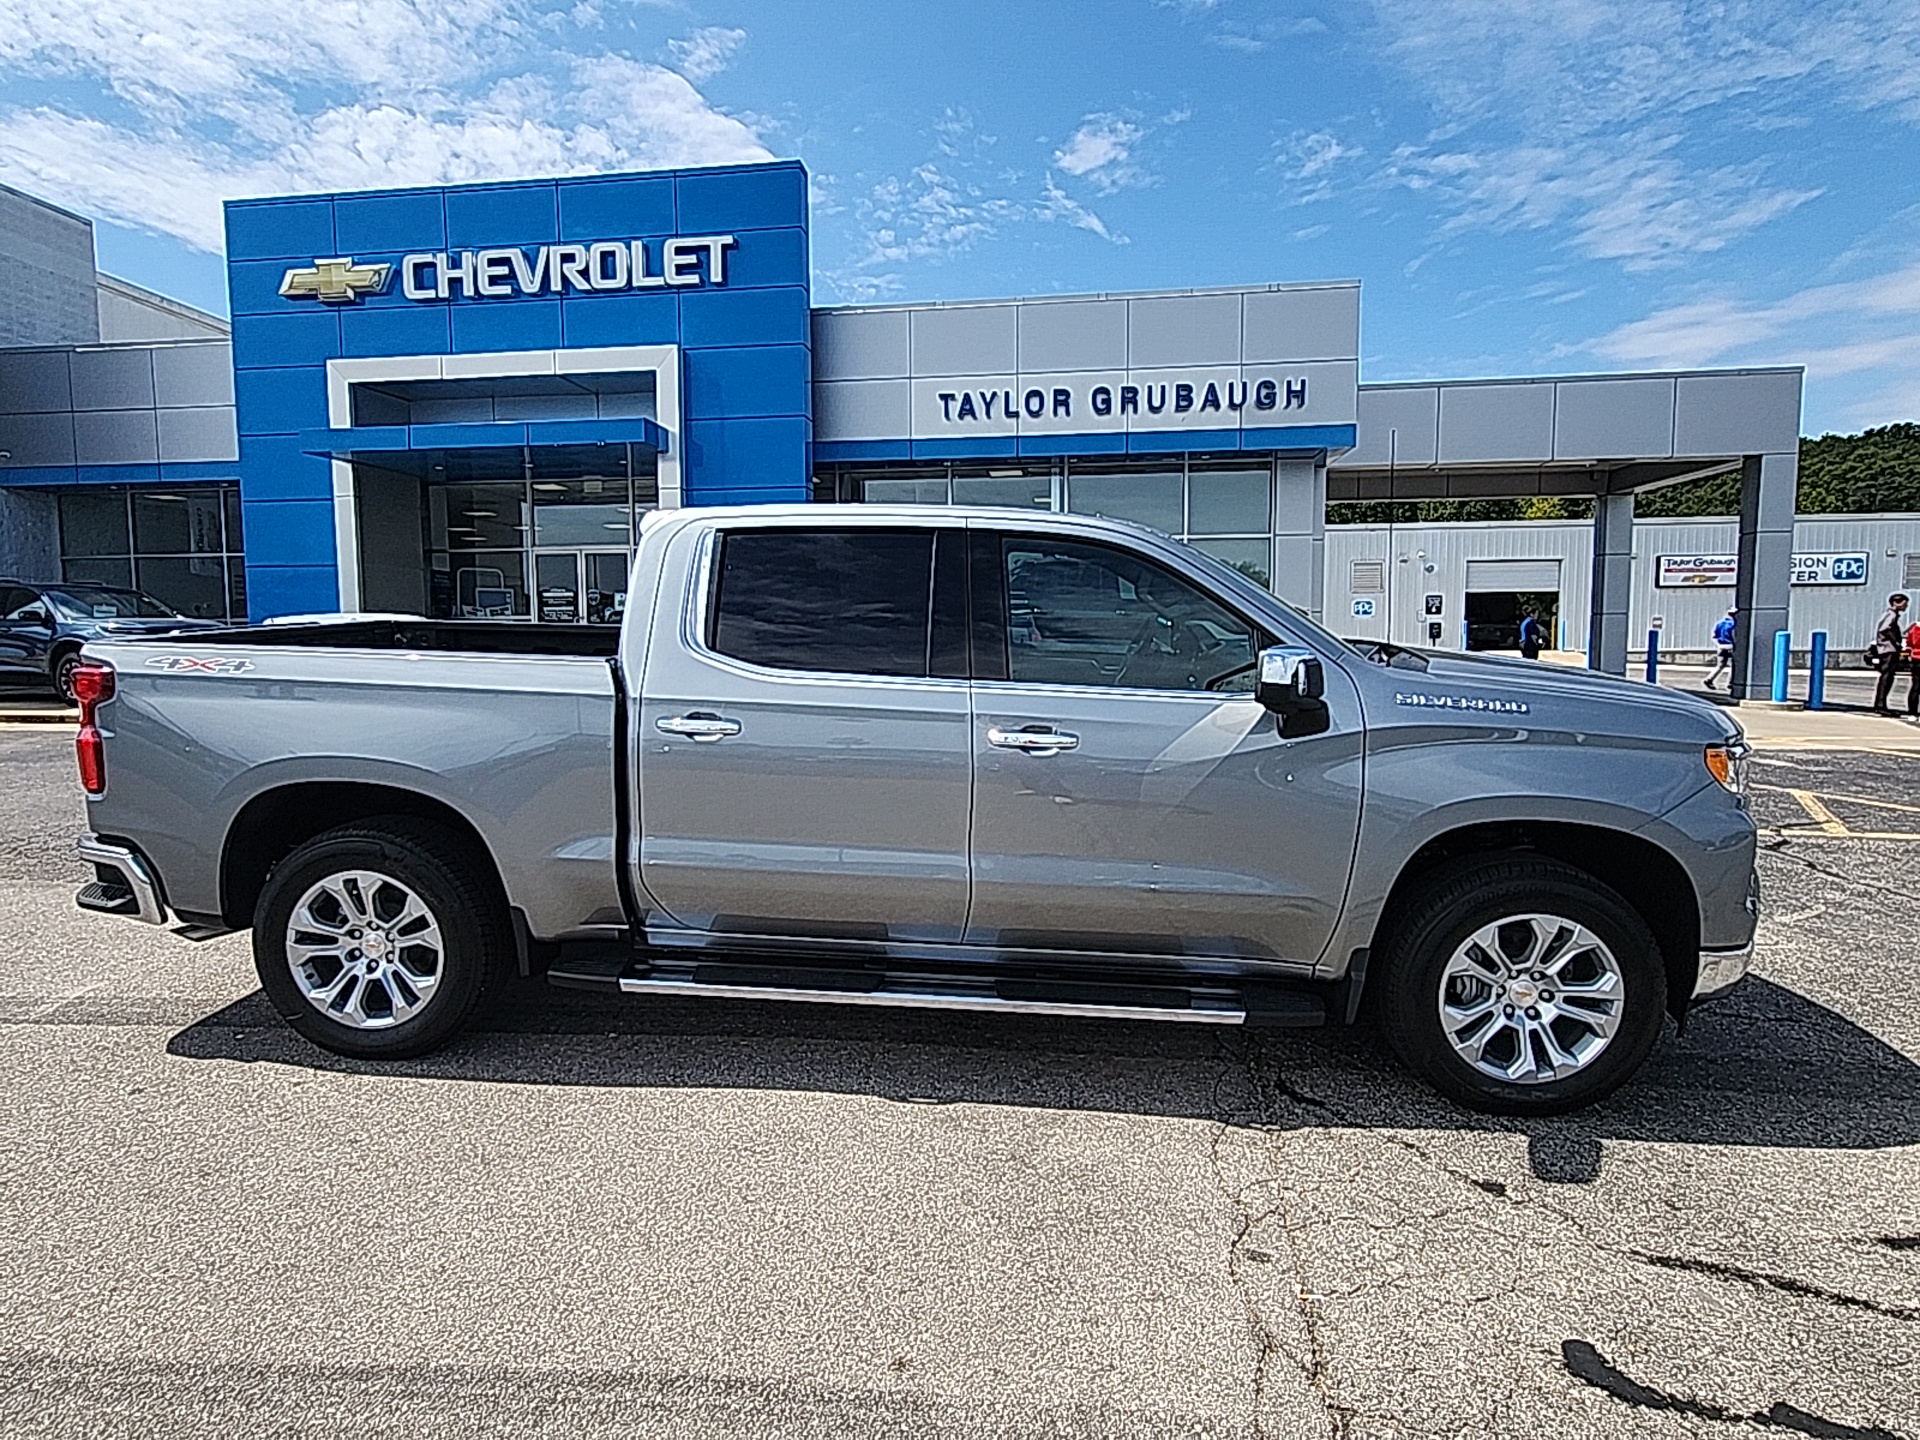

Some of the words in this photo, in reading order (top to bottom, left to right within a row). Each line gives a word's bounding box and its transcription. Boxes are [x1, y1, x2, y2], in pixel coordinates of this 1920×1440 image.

[402, 235, 734, 299] CHEVROLET
[938, 387, 1074, 422] TAYLOR
[1091, 378, 1308, 417] GRUBAUGH
[1664, 558, 1692, 568] Taylor
[1834, 559, 1864, 578] PPG
[1395, 692, 1529, 714] SILVERADO
